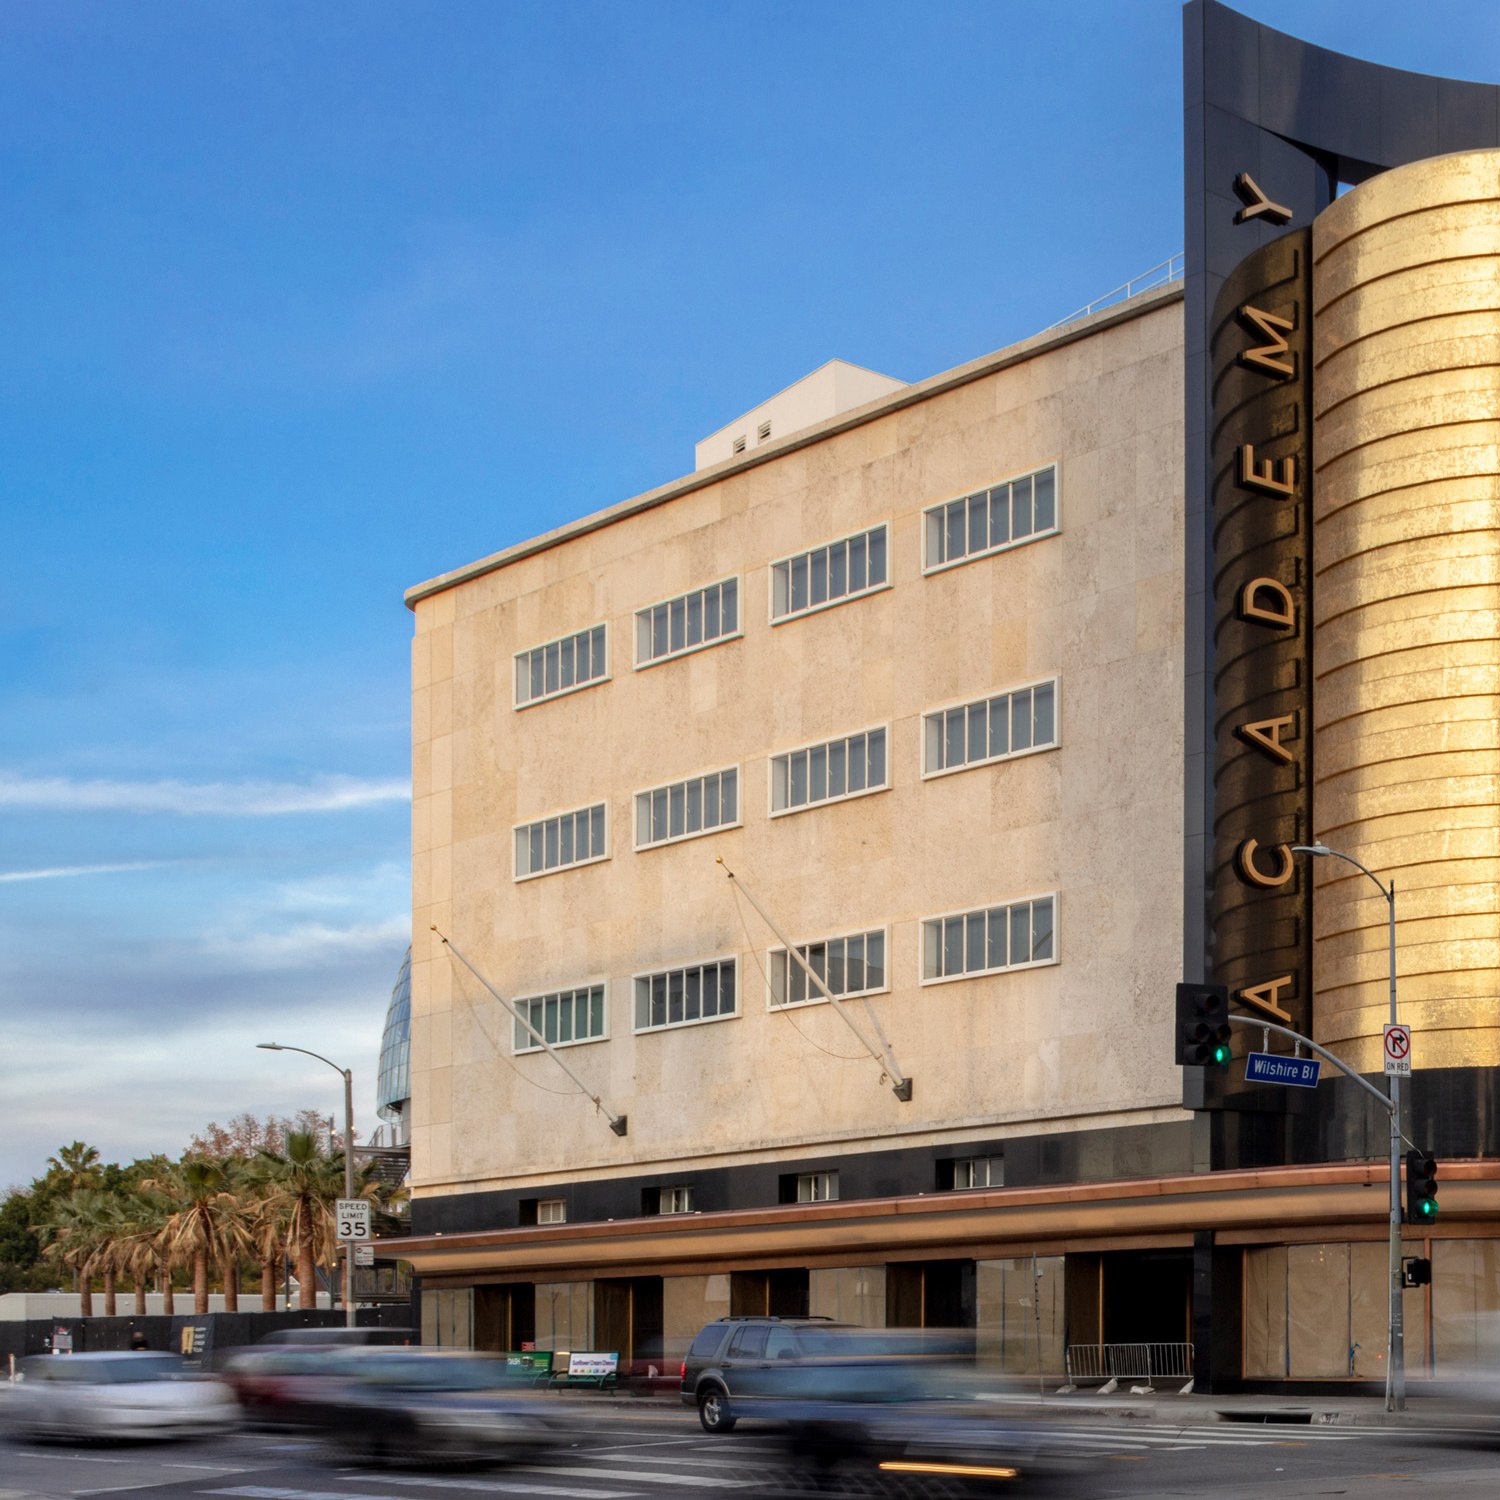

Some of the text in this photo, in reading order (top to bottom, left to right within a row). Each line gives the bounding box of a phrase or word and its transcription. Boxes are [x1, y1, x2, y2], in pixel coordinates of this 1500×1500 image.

[1233, 172, 1295, 1024] ACADEMY
[1254, 1060, 1314, 1080] Wilshire Bl
[1386, 1062, 1409, 1072] ON RED
[340, 1221, 366, 1236] 35
